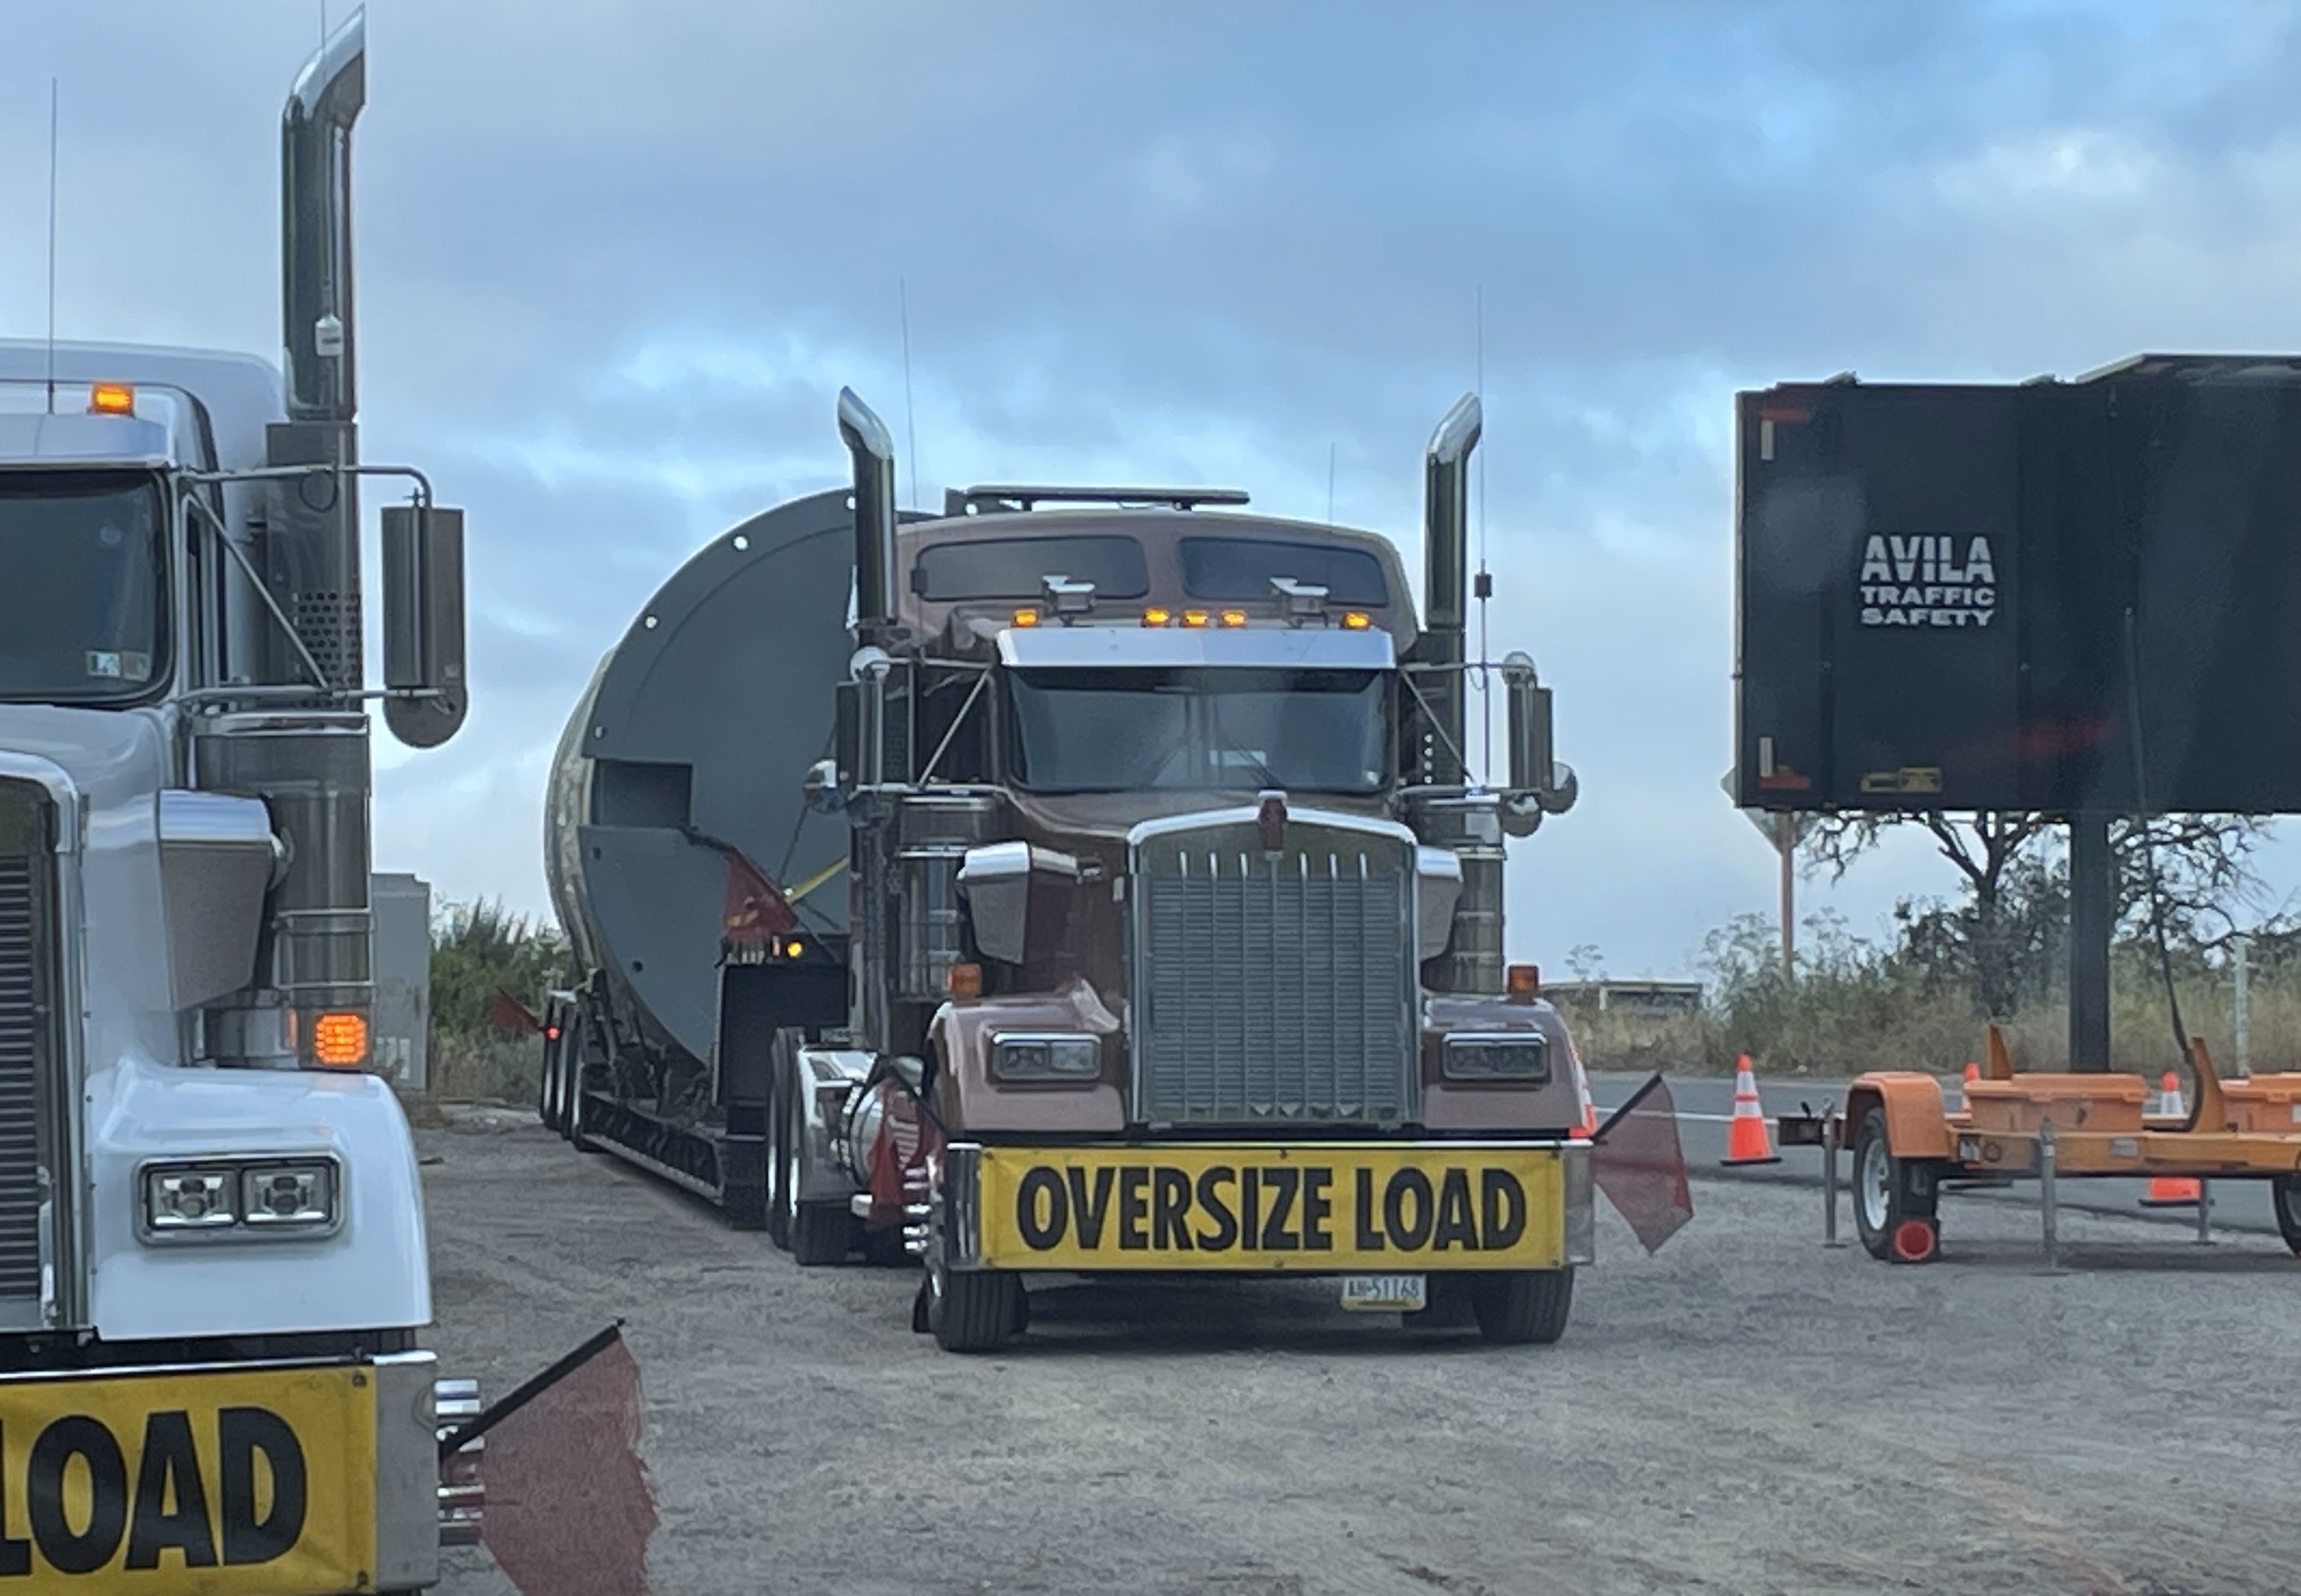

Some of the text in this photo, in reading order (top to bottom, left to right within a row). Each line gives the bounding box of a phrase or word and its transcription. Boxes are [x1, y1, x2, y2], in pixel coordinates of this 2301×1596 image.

[1860, 535, 1995, 583] AVILA
[1860, 585, 1995, 607] TRAFFIC
[1860, 607, 1995, 627] SAFETY
[1016, 1166, 1526, 1251] OVERSIZE LOAD
